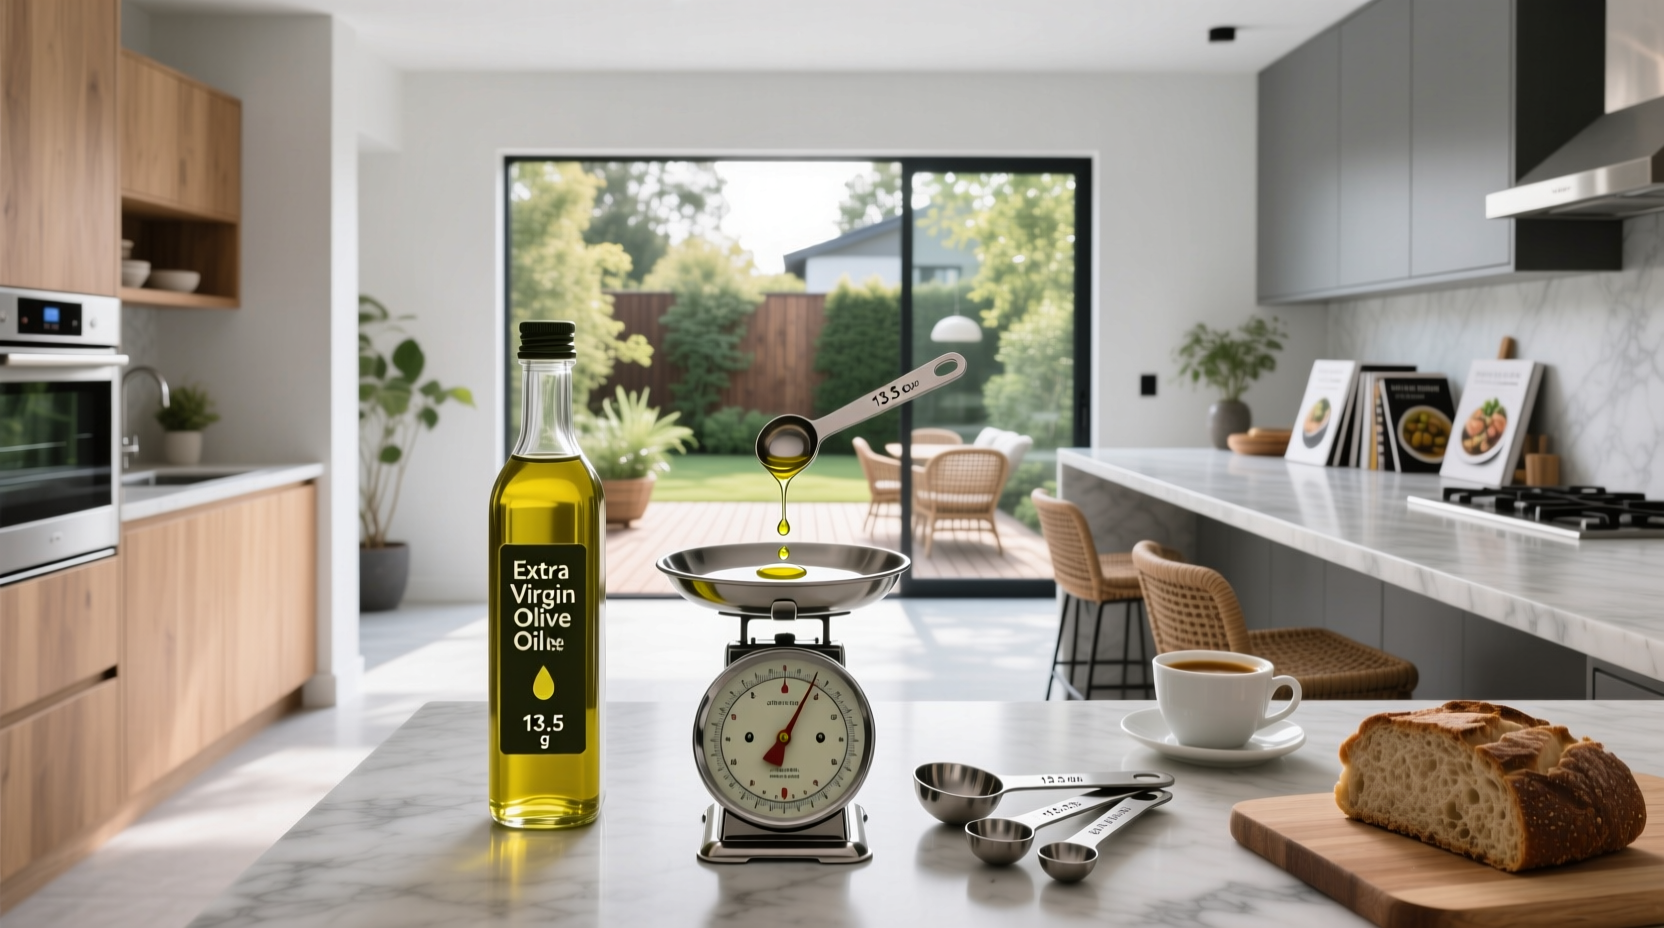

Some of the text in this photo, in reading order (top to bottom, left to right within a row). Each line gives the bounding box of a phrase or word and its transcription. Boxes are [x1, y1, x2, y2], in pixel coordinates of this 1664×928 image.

[513, 560, 569, 580] Extra
[510, 583, 576, 609] Virgin
[513, 607, 572, 628] Olive
[522, 714, 564, 732] 13.5
[540, 734, 550, 749] g
